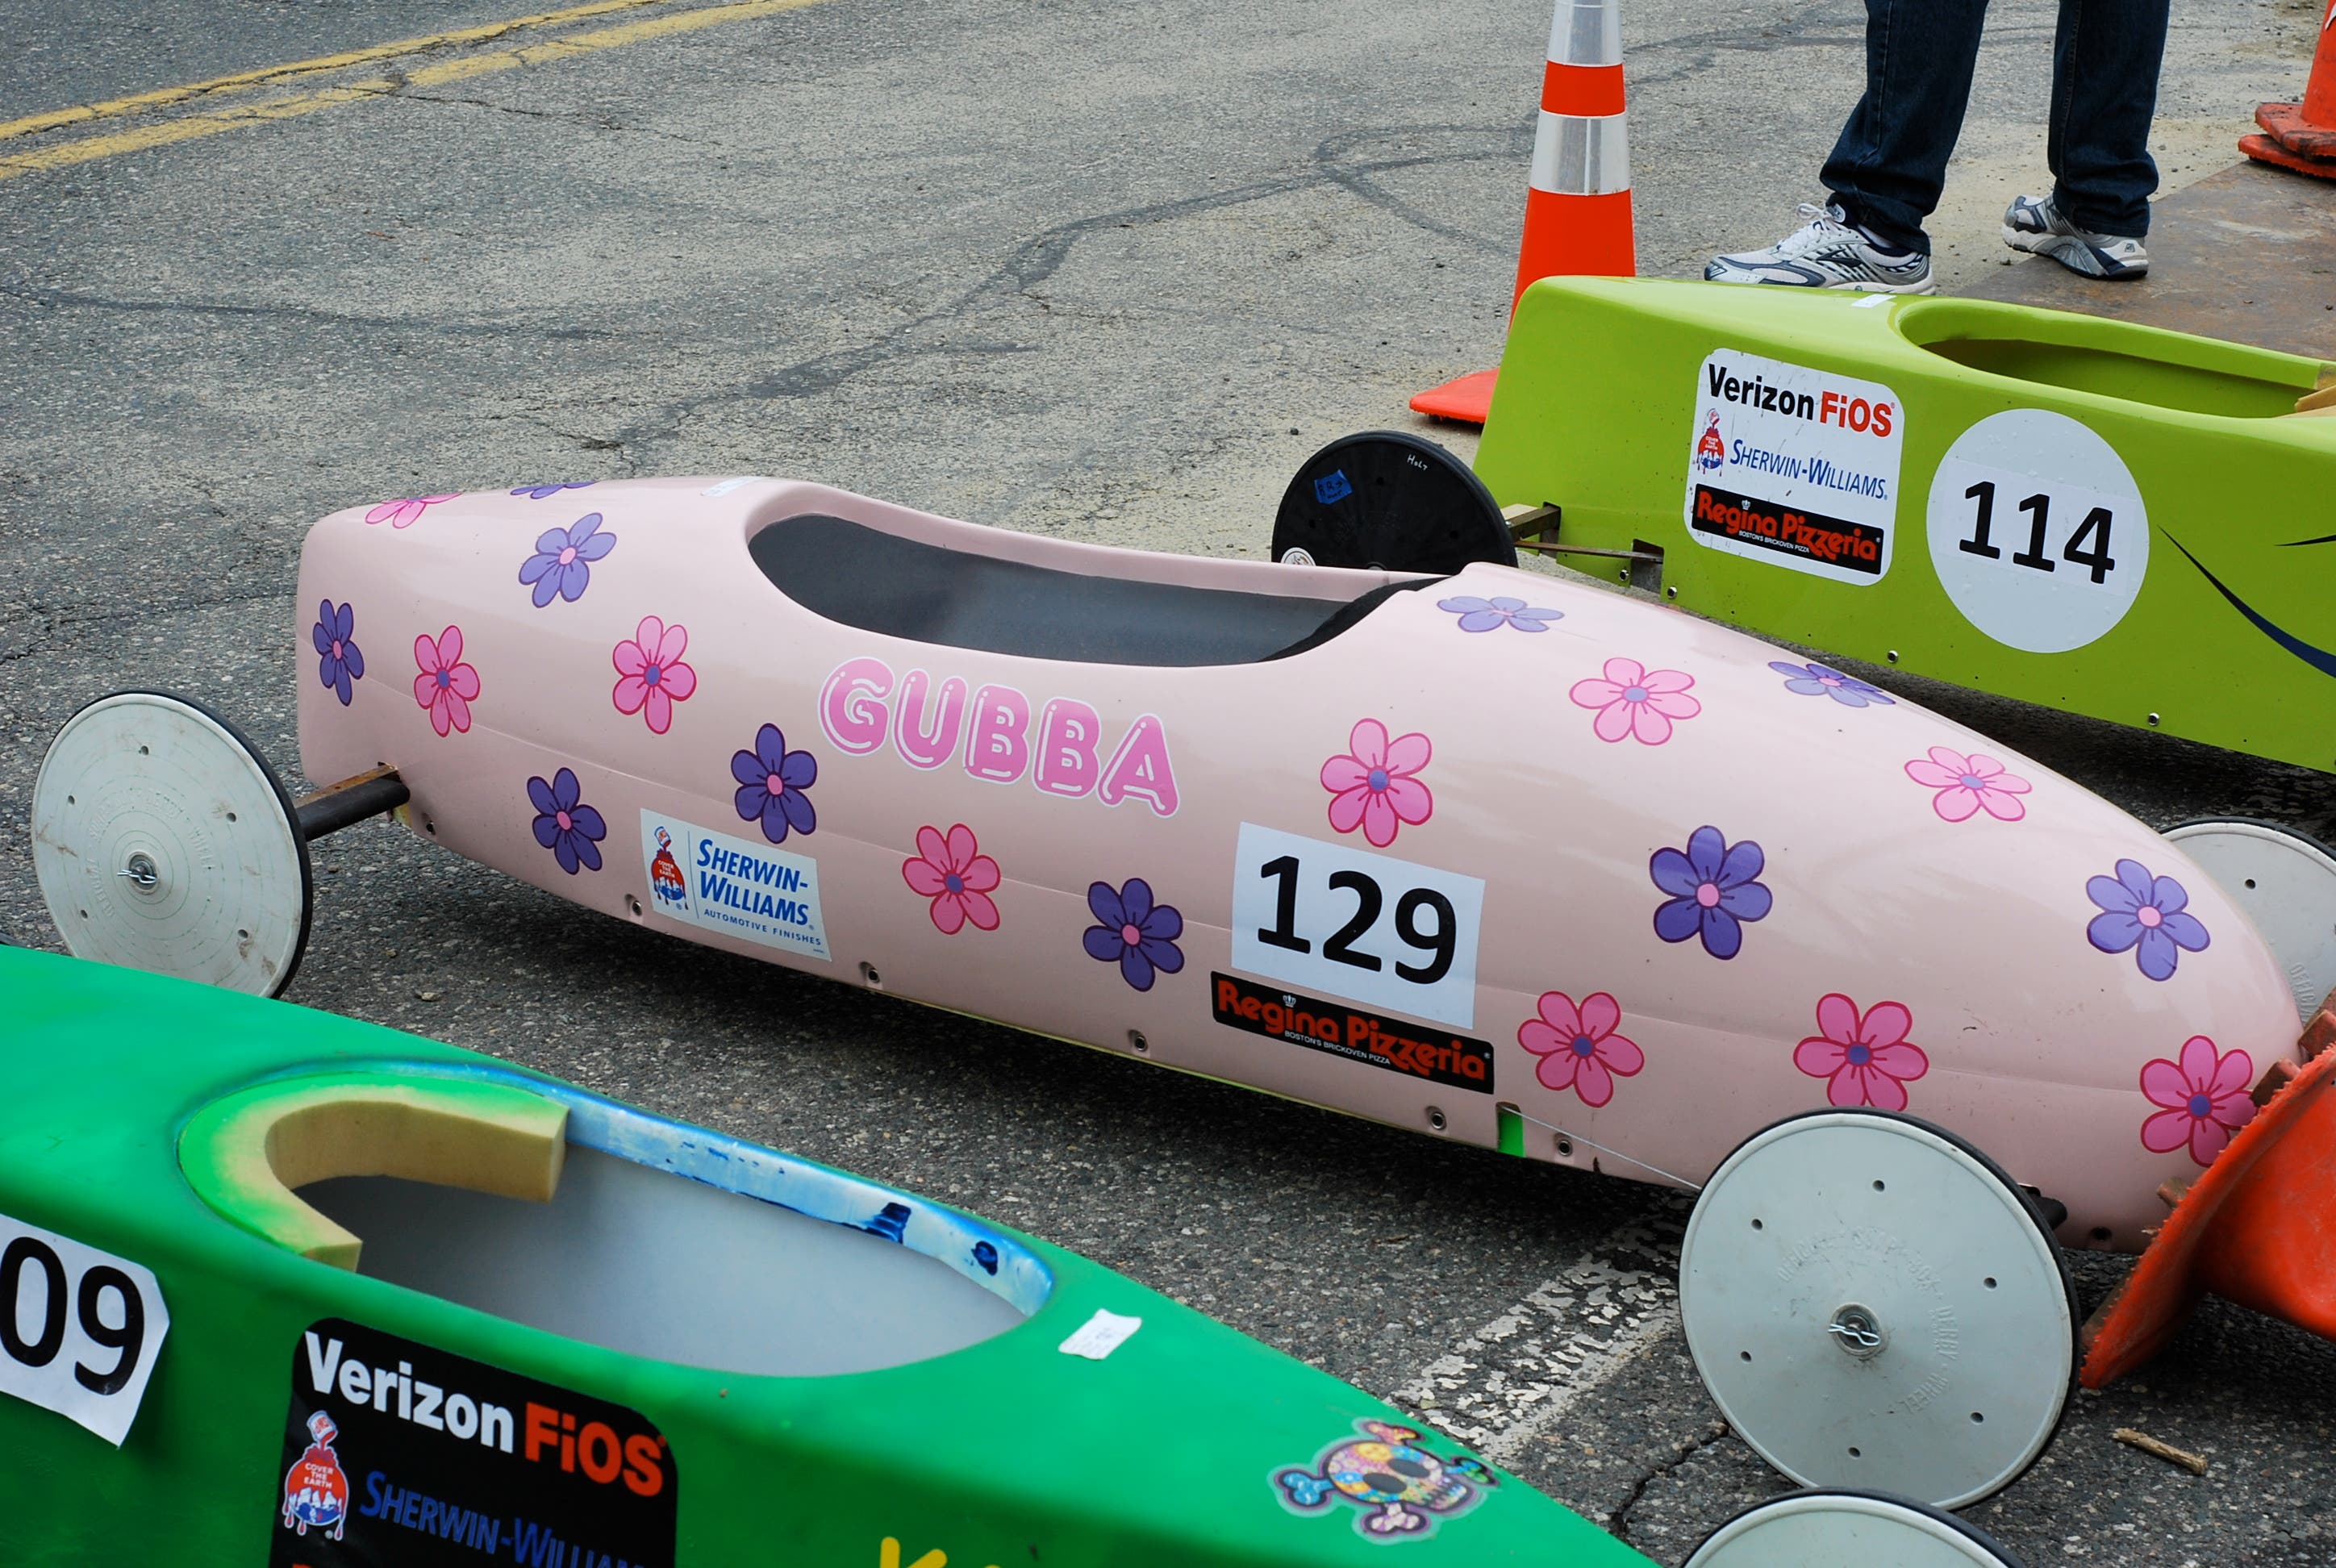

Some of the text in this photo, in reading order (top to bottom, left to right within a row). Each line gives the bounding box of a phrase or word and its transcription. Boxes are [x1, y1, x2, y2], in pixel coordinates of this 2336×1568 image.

[1708, 363, 1892, 438] Verizon FiOS
[1696, 490, 1877, 561] Regina Pizzeria
[1795, 544, 1810, 553] PIZZA
[1958, 481, 2115, 585] 114
[817, 657, 1181, 819] GUBBA
[700, 870, 809, 926] WILLIAMS
[703, 909, 822, 946] AUTOMOTIVE FINISHES
[1258, 855, 1457, 985] 129
[1217, 979, 1486, 1081] Regina Pizzeria
[1284, 1030, 1391, 1065] BOSTON'S BRICKOVEN PIZZA
[0, 1236, 145, 1396] 09
[305, 1331, 664, 1497] Verizon FiOS
[303, 1477, 333, 1488] EARTH
[305, 1462, 334, 1474] COVER
[311, 1470, 327, 1481] THE
